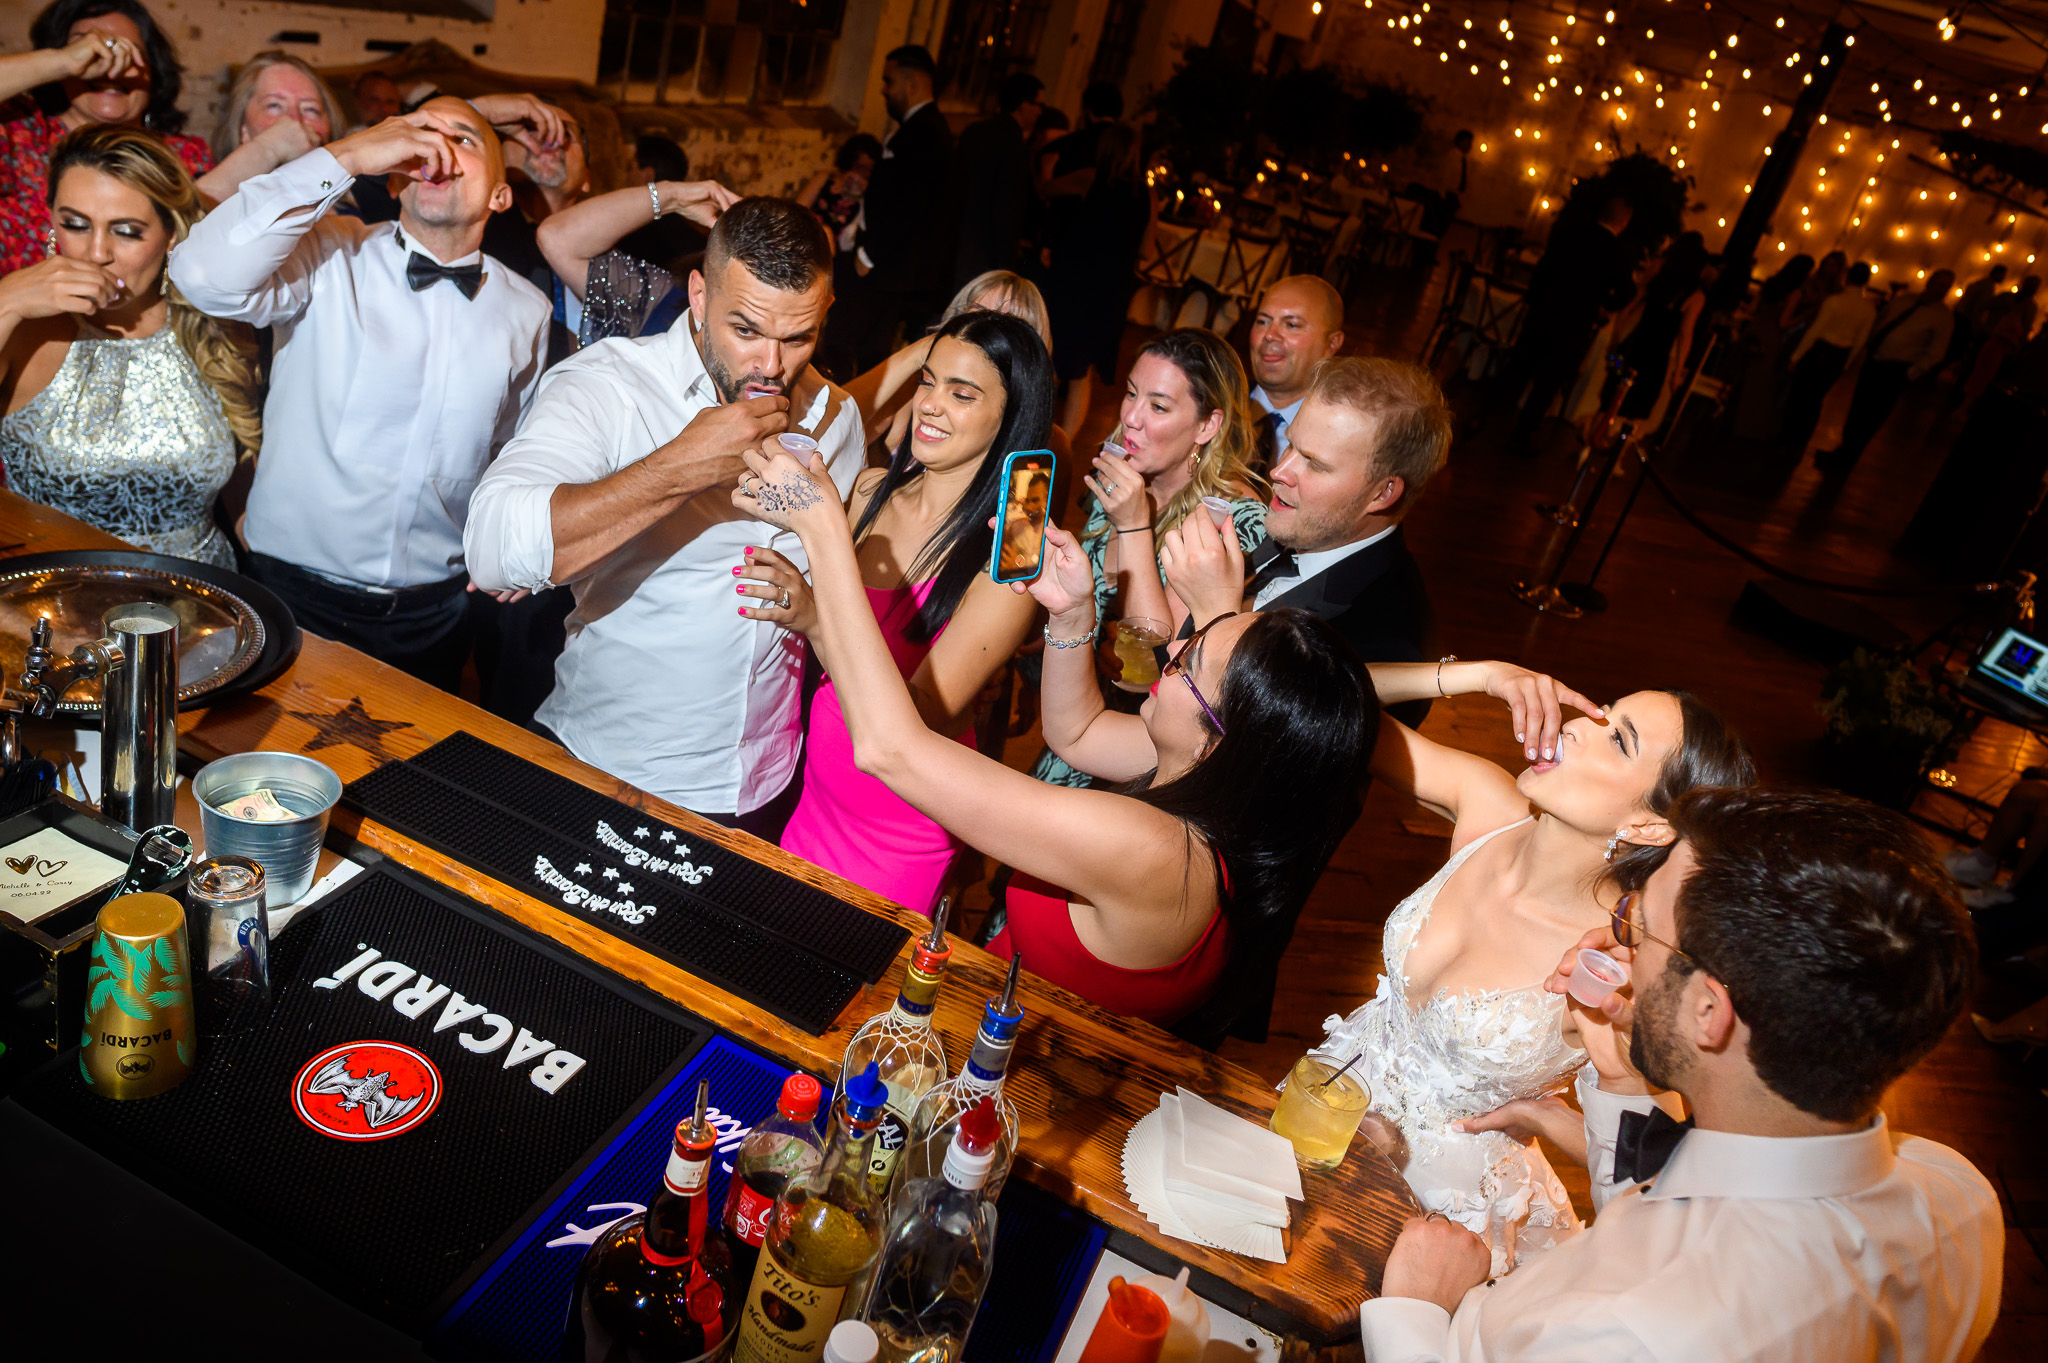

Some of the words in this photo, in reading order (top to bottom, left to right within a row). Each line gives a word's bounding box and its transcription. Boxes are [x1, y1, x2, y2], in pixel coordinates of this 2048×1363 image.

[642, 856, 670, 872] del
[668, 861, 714, 885] Ron
[11, 890, 52, 898] 06.04.22
[582, 894, 611, 911] del
[608, 900, 657, 924] Ron
[312, 947, 587, 1095] BACARDÍ
[100, 1028, 172, 1048] BACARDÍ
[763, 1262, 821, 1306] Tito's
[748, 1303, 817, 1353] Handmade
[755, 1331, 789, 1358] VODKA
